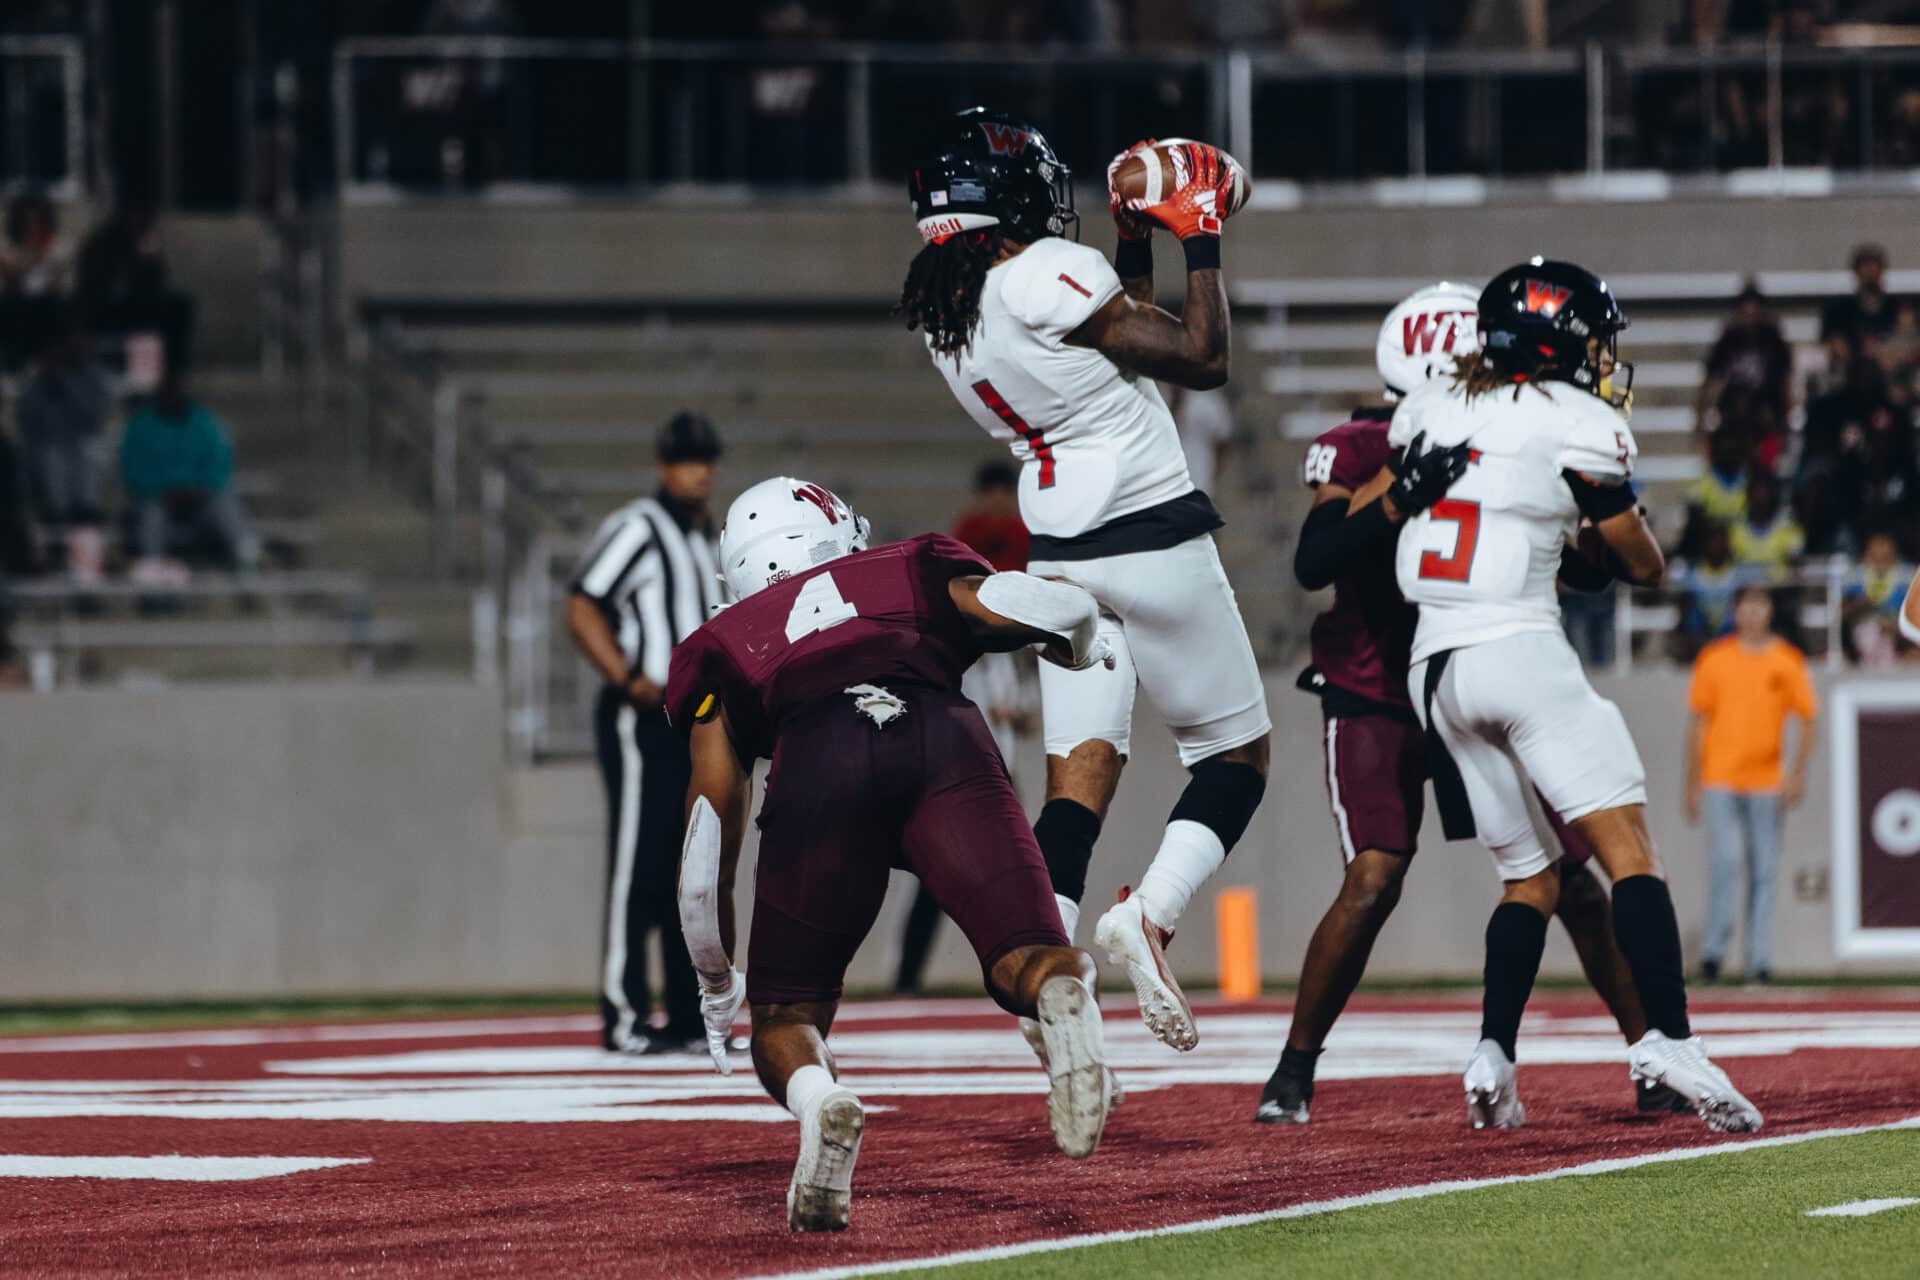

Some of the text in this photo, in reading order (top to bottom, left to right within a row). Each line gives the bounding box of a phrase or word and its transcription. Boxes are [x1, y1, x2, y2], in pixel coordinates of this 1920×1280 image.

[979, 122, 1029, 156] W
[1058, 273, 1092, 298] 1
[1524, 279, 1576, 321] W
[971, 378, 1056, 491] 1
[1305, 443, 1338, 485] 28
[1418, 449, 1482, 583] 5
[785, 571, 858, 644] 4
